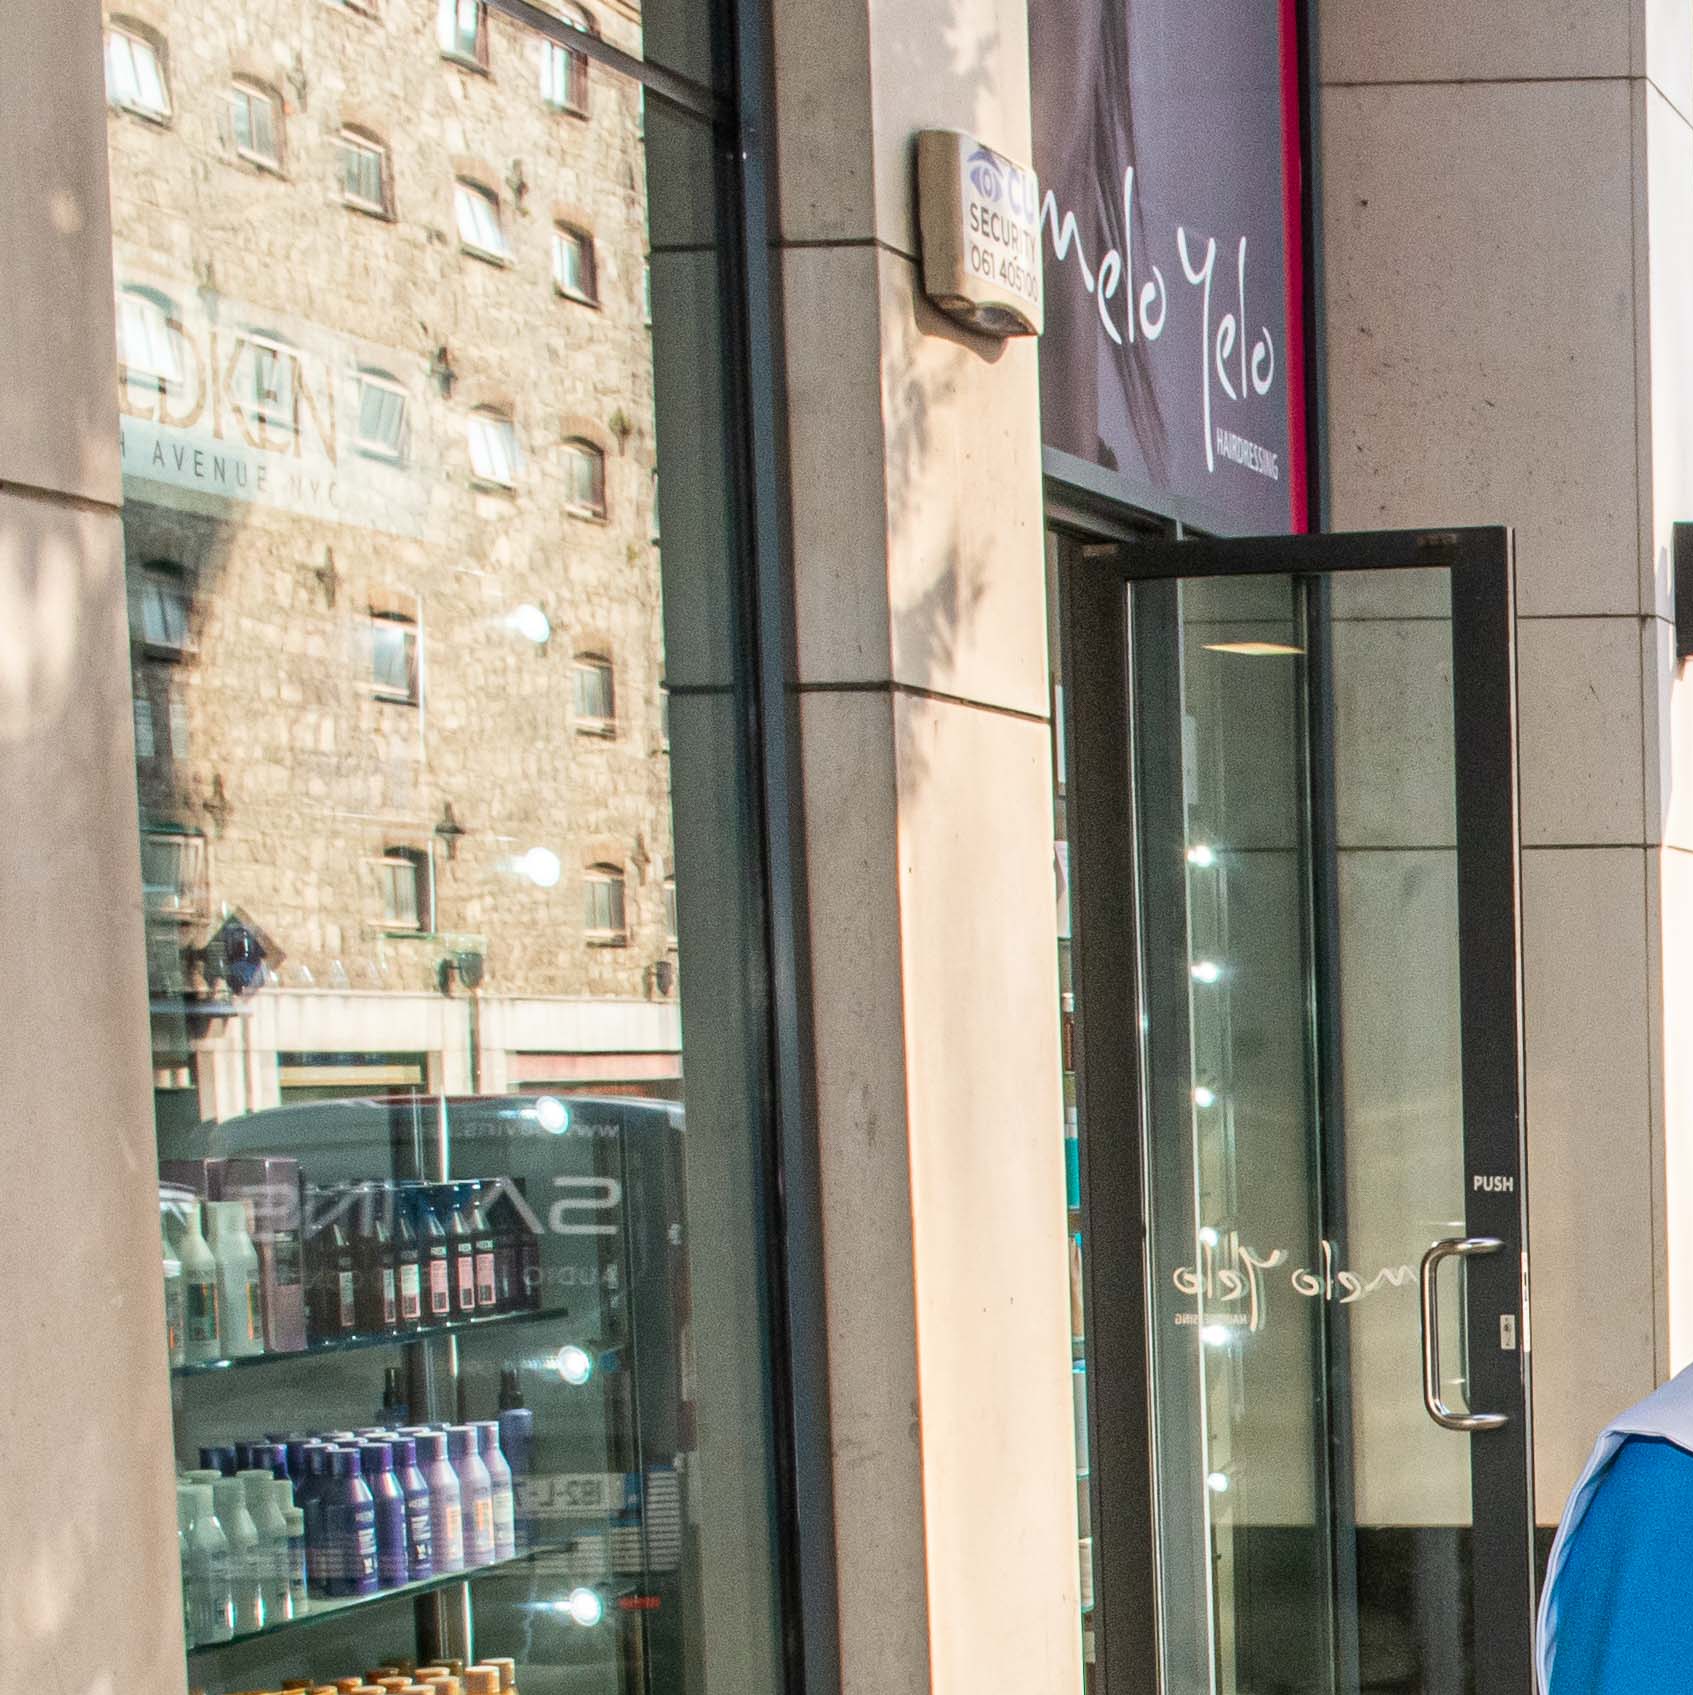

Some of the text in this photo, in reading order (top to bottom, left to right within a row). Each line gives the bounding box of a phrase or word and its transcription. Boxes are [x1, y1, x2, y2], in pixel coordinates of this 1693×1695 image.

[968, 203, 1037, 264] SECURITY
[152, 439, 268, 493] AVENUE
[1216, 426, 1279, 481] HAIRDRESSING
[1473, 1175, 1514, 1192] PUSH
